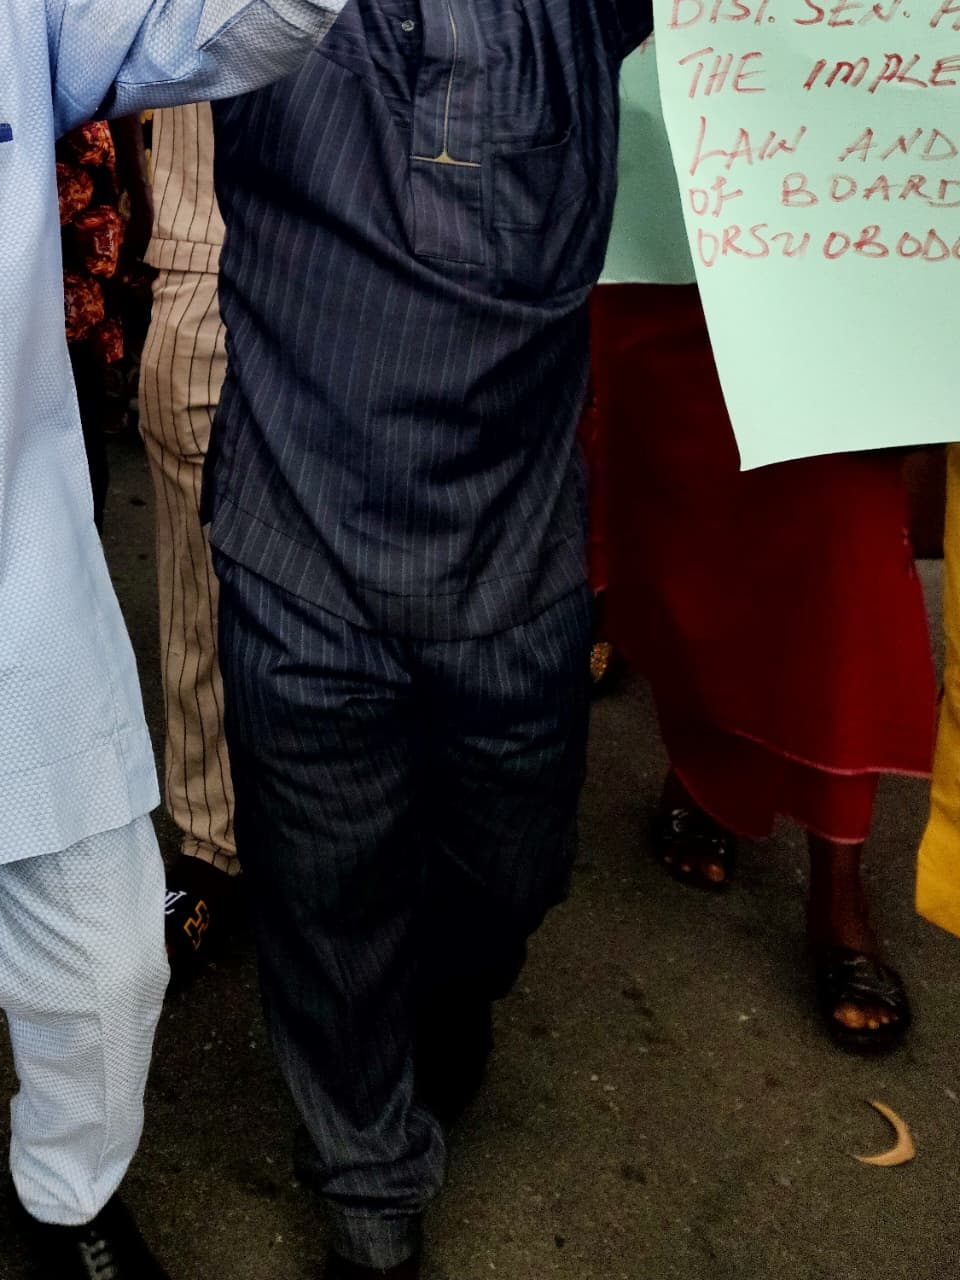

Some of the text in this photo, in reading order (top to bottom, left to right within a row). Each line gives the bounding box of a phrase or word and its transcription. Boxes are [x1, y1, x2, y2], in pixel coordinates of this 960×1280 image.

[678, 46, 960, 99] THE IMPLE
[689, 115, 960, 176] LAW AND
[689, 175, 744, 218] OF
